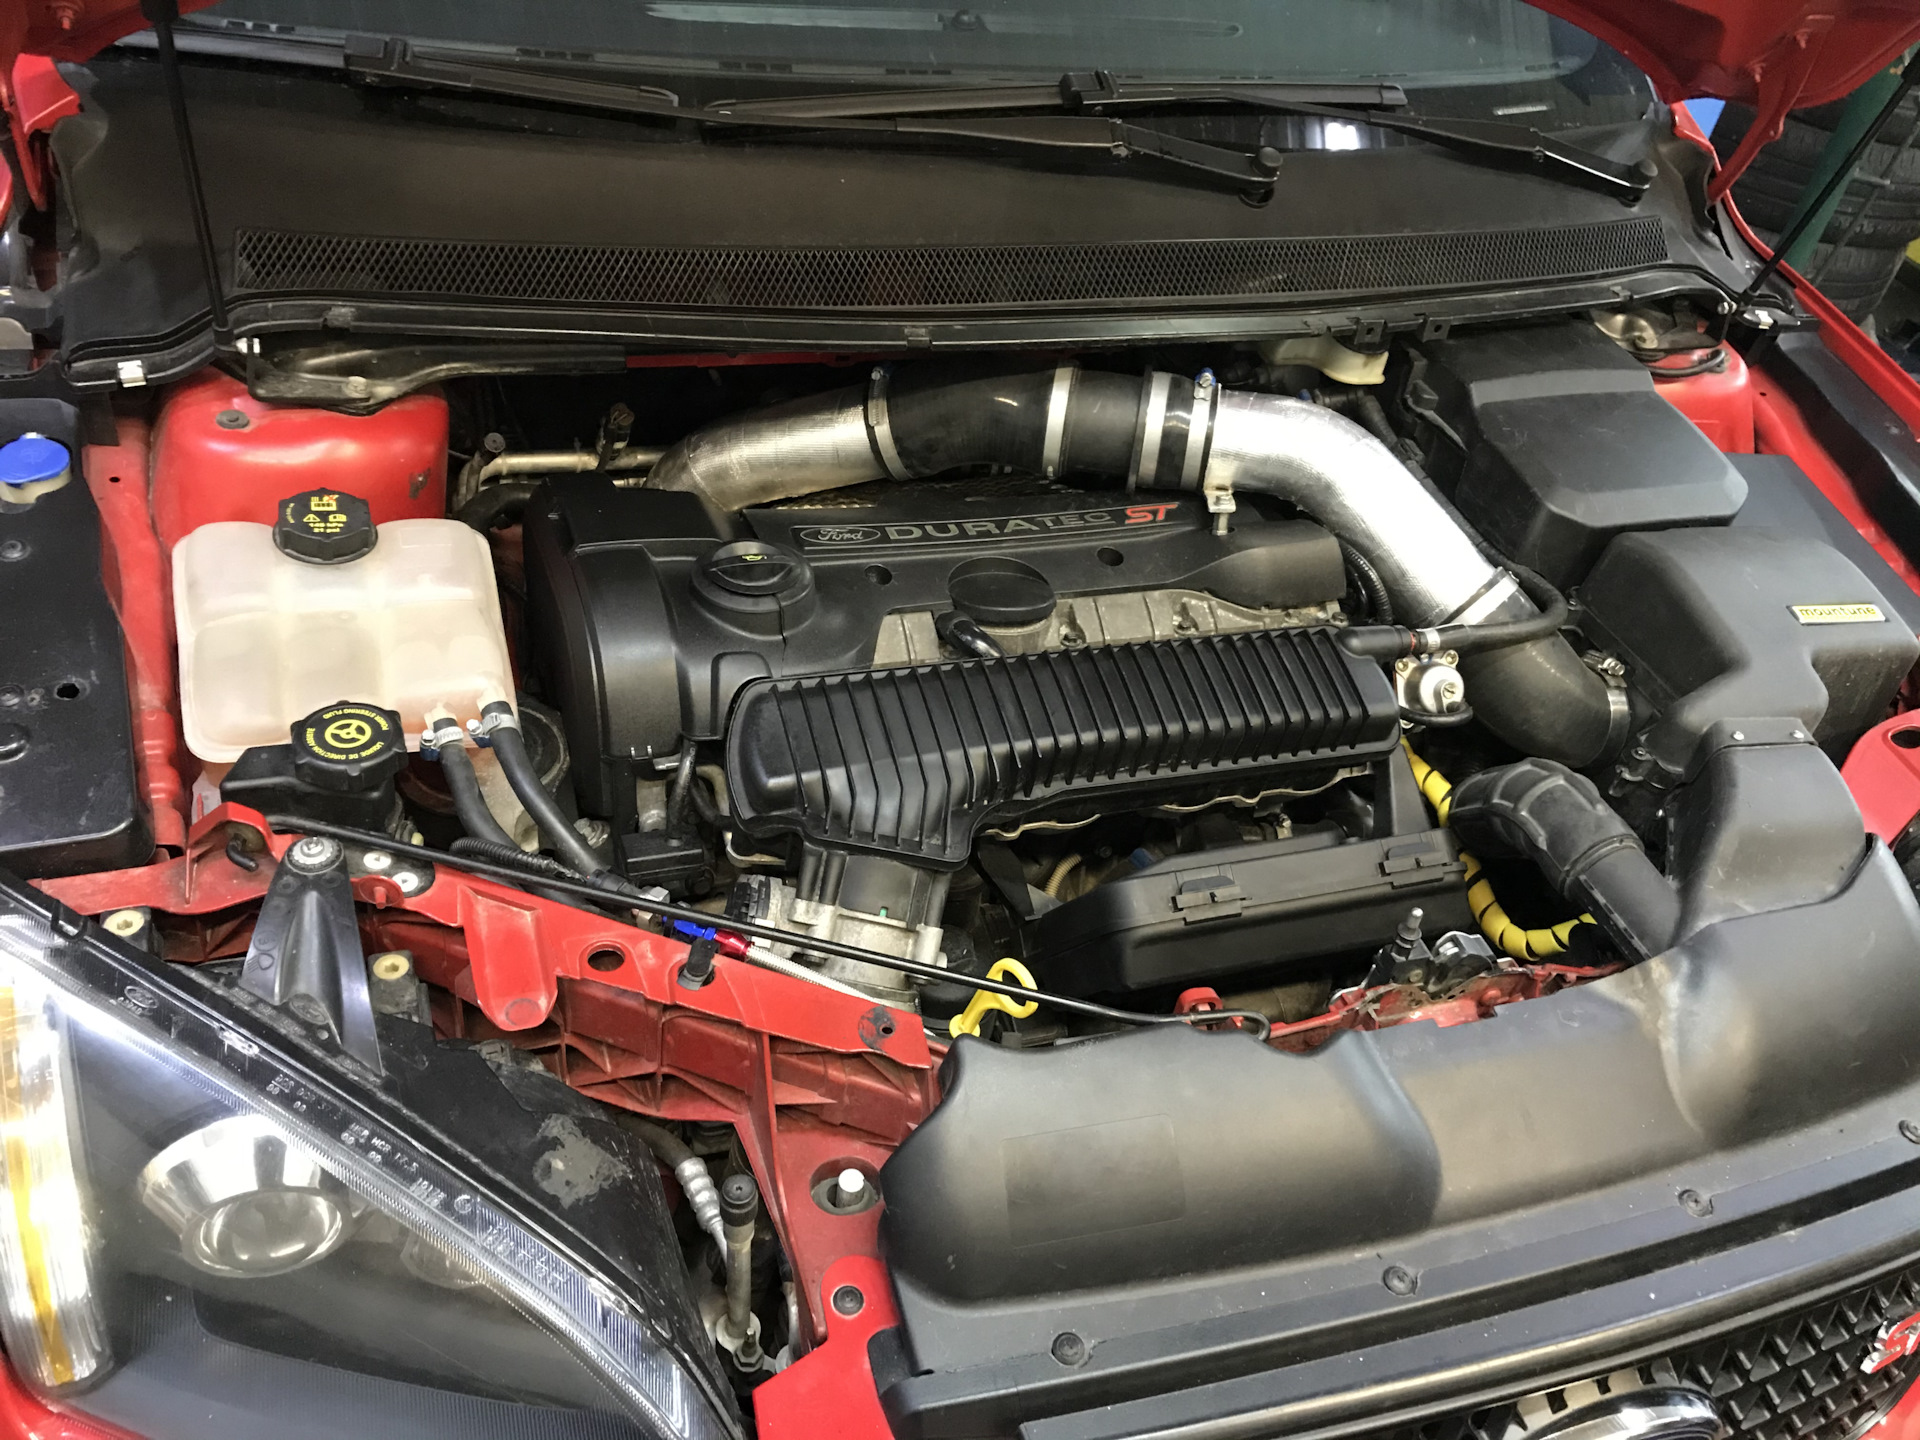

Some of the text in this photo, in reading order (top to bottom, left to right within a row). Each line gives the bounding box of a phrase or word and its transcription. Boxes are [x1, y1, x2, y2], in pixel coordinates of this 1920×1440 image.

[816, 503, 1179, 542] Ford DURATEC ST
[1799, 605, 1876, 617] mountune
[322, 709, 343, 719] FLUID
[343, 708, 376, 718] STEERING
[311, 742, 347, 760] DIRECTION
